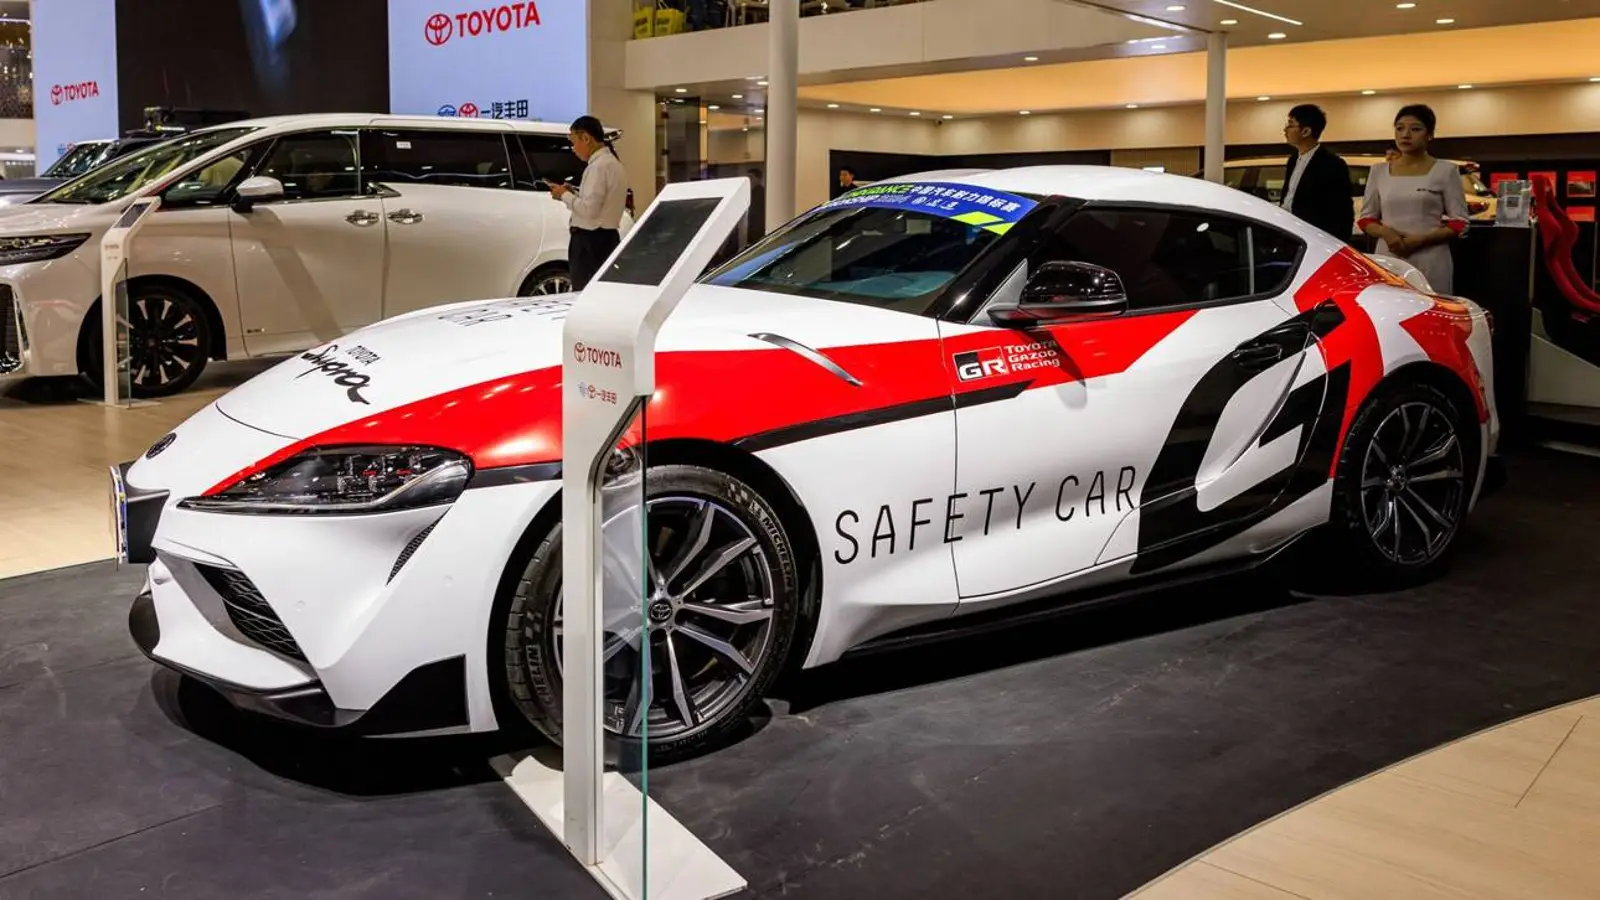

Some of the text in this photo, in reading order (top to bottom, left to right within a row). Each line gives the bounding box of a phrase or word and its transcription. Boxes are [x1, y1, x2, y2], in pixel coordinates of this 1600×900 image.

[456, 1, 541, 37] TOYOTA
[64, 81, 99, 100] TOYOTA
[480, 99, 529, 119] 一汽丰田
[1004, 340, 1057, 354] TOYOTA
[1008, 350, 1057, 363] GAZOO
[587, 347, 623, 369] TOYOTA
[1011, 358, 1060, 372] Racing
[958, 357, 1008, 380] GR
[834, 465, 1136, 565] SAFETY CAR
